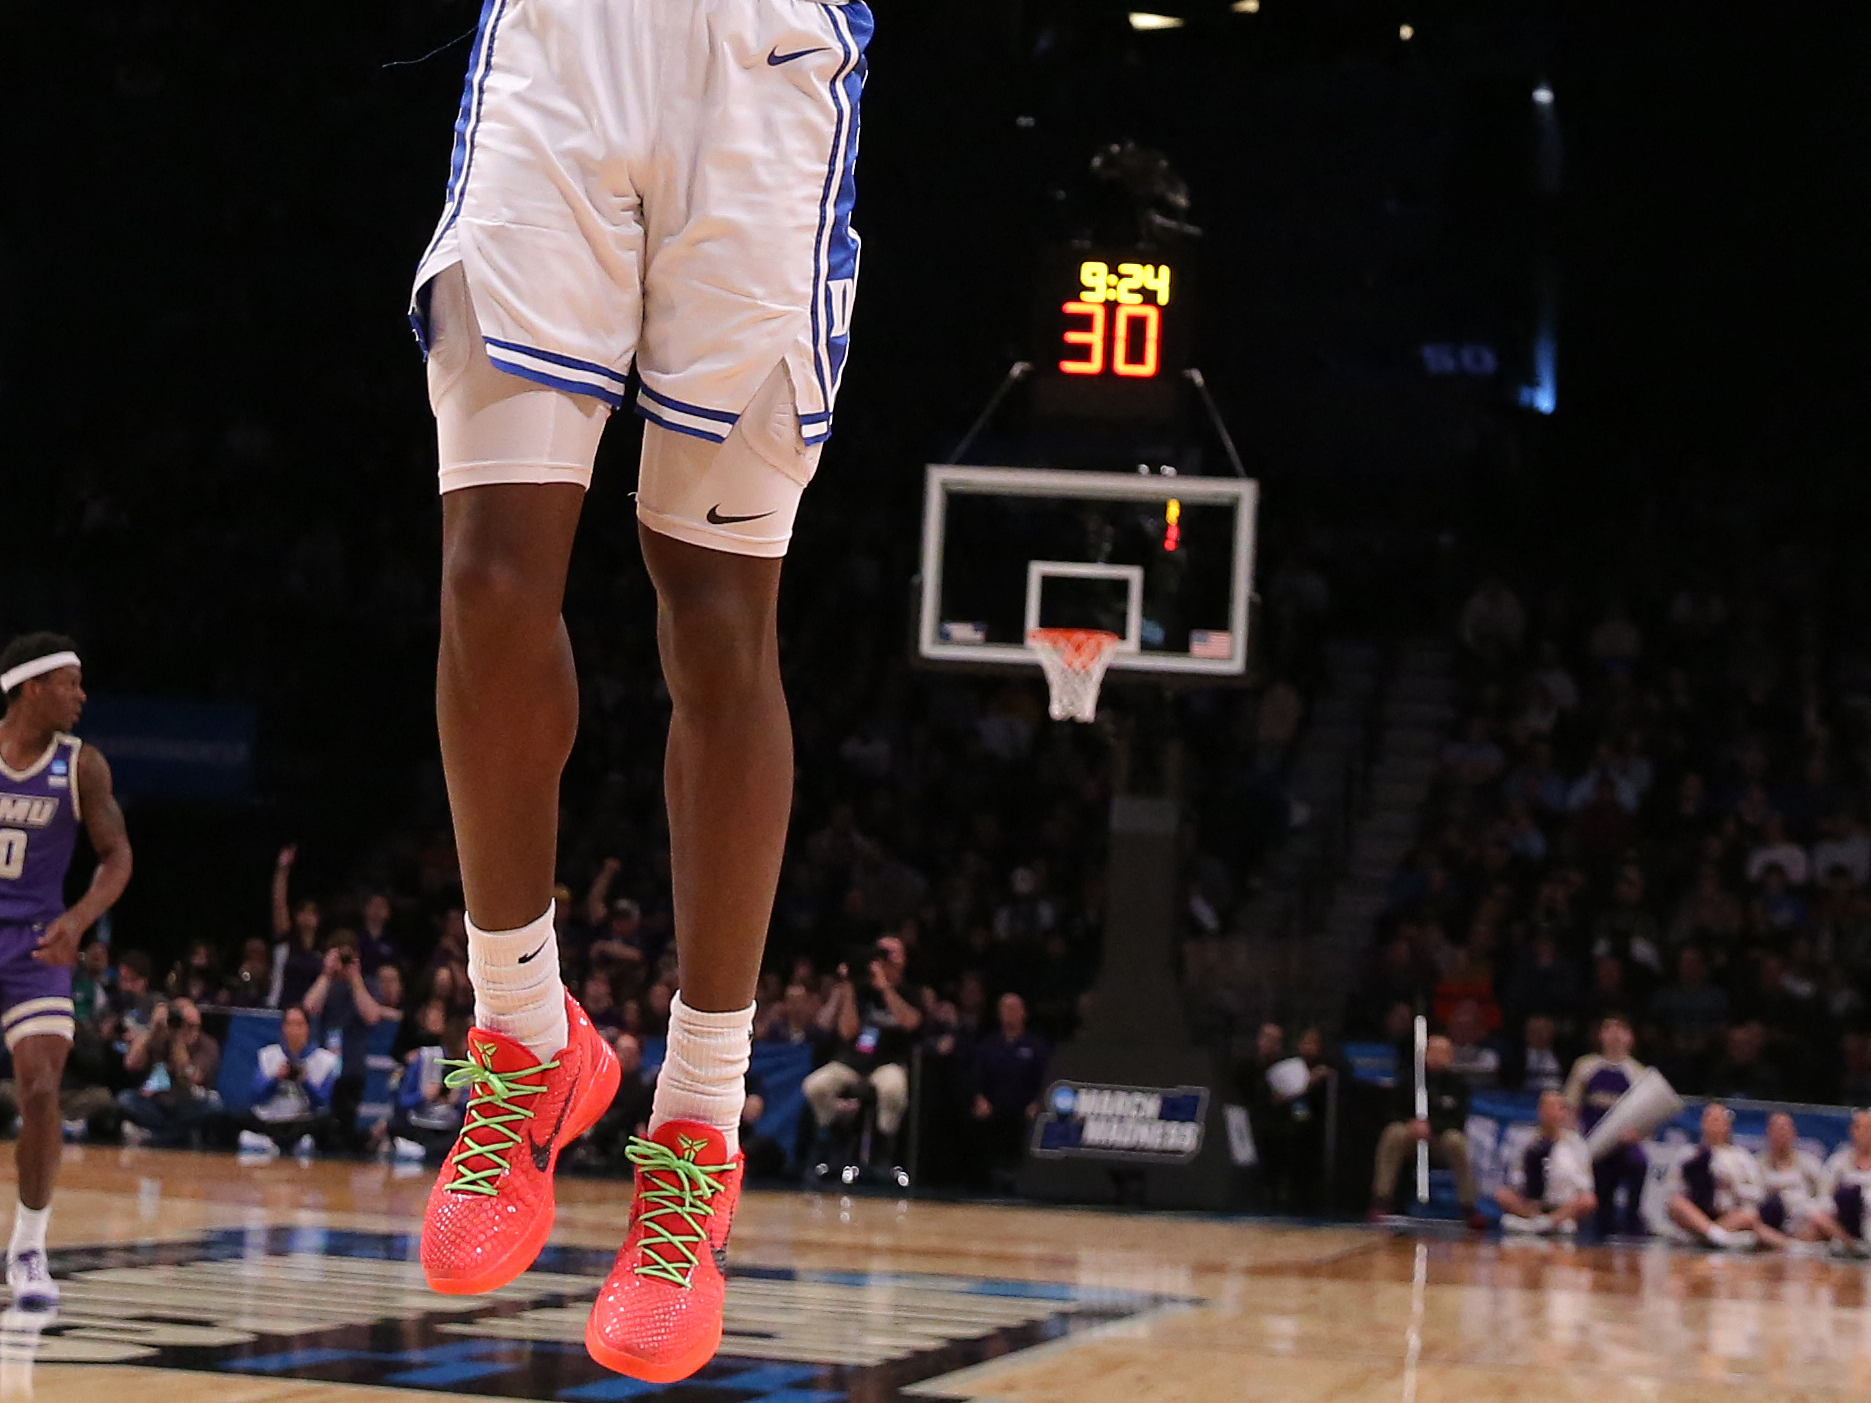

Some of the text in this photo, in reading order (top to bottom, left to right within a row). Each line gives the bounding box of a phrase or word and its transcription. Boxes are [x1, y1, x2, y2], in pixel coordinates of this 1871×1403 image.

[1079, 261, 1171, 306] 9:24
[1058, 301, 1161, 377] 30
[0, 795, 59, 826] MU
